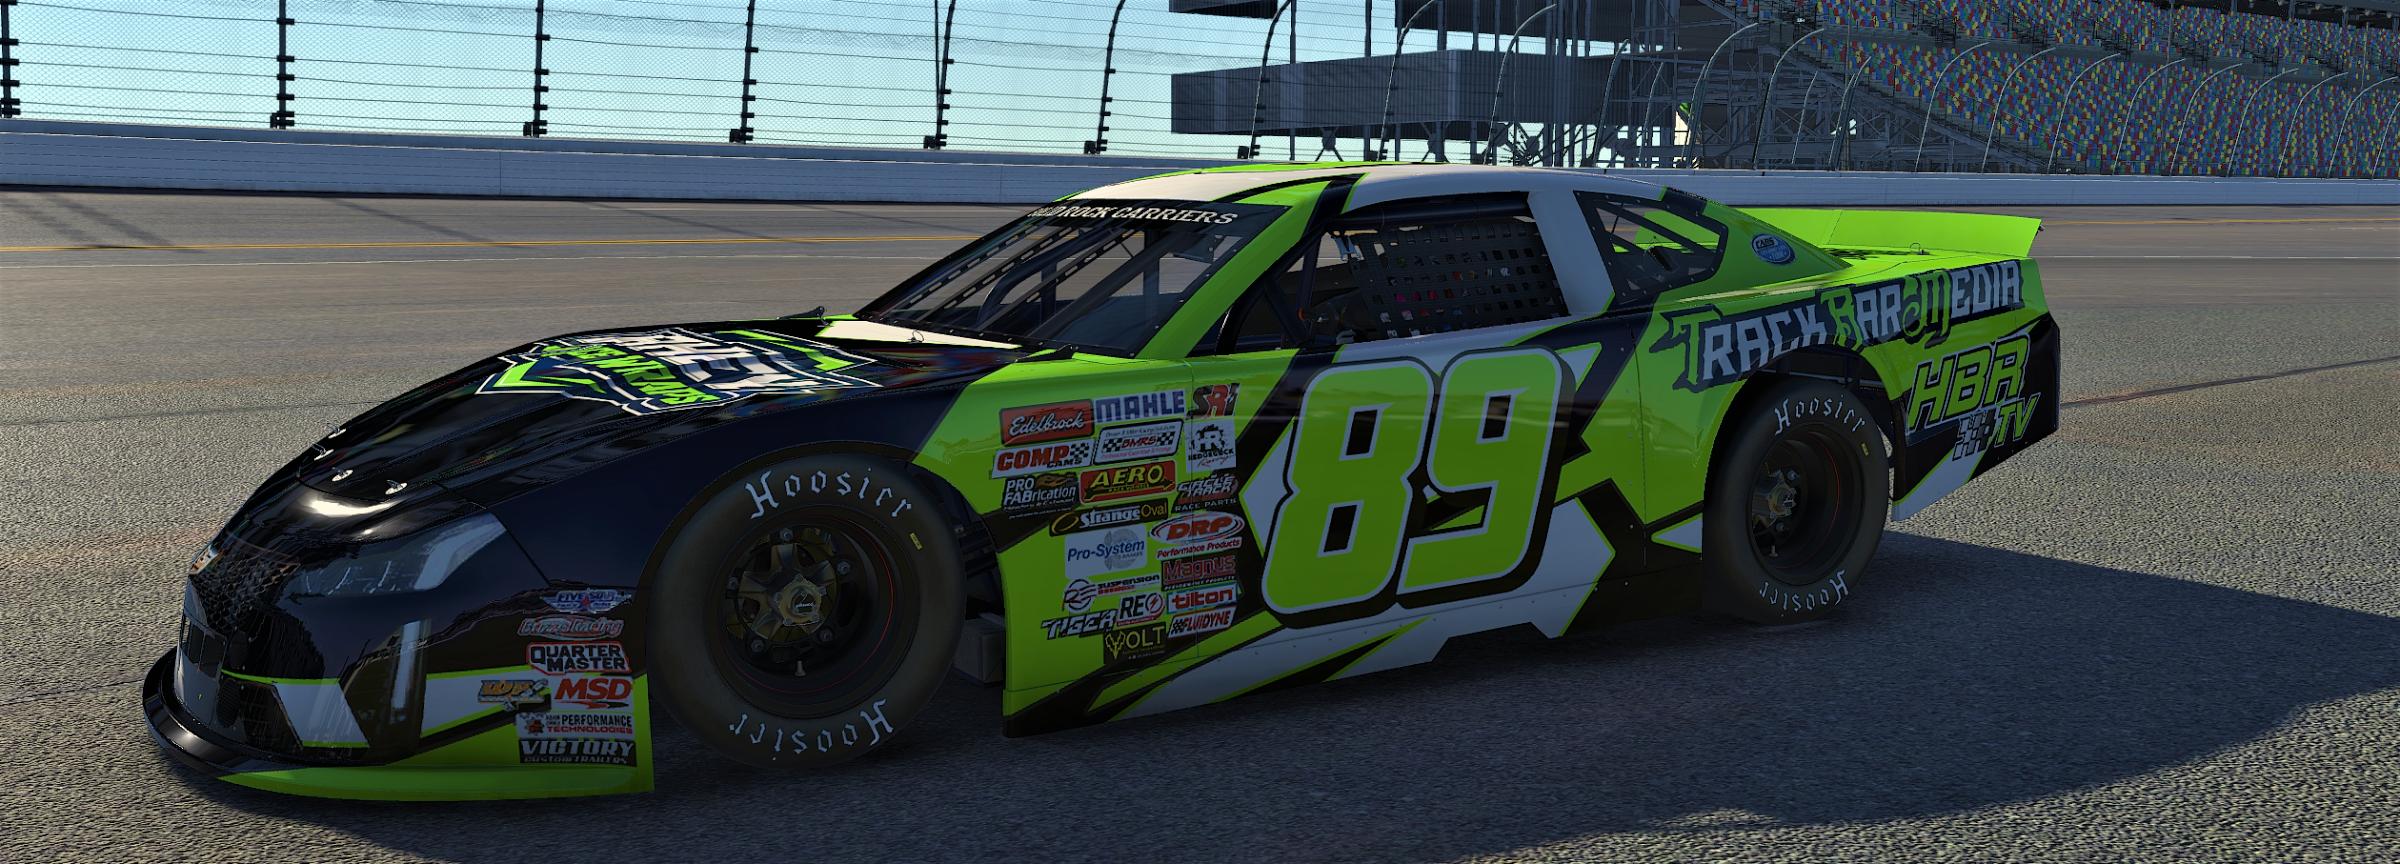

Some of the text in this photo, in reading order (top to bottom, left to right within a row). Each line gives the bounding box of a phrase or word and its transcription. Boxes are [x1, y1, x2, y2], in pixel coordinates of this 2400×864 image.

[1057, 206, 1114, 218] ROCK
[1112, 207, 1238, 224] CARRIERS
[1907, 335, 2031, 433] HBR
[1095, 391, 1185, 423] MAHLE
[1774, 394, 1866, 436] Hoosier
[1009, 410, 1085, 437] Edelbrock
[1994, 393, 2041, 447] TV
[997, 445, 1070, 472] COMP
[1047, 455, 1083, 468] CAMS
[1006, 478, 1034, 494] PRO
[1090, 463, 1164, 489] AERO
[1261, 347, 1565, 616] 89
[745, 468, 912, 519] Hoosier
[1003, 486, 1076, 506] FABrication
[1175, 502, 1201, 511] RACE
[1204, 497, 1237, 508] PARTS
[1141, 502, 1168, 518] Oval
[1167, 517, 1233, 541] DRP
[1067, 541, 1145, 562] Pro-System
[1157, 539, 1241, 559] Performance Products
[1163, 555, 1236, 581] Magnus
[557, 591, 584, 602] FIVE
[1171, 589, 1233, 609] tilton
[1760, 569, 1849, 616] Hoosier
[1181, 610, 1231, 632] FLUIDYNE
[1104, 625, 1165, 660] VOLT
[530, 645, 621, 665] QUARTER
[547, 658, 626, 673] MASTER
[555, 678, 633, 700] MSD
[547, 726, 633, 735] TECHNOLOGIES
[562, 714, 632, 727] PERFORMANCE
[729, 699, 894, 761] Hoosier
[521, 740, 634, 757] VICTORY
